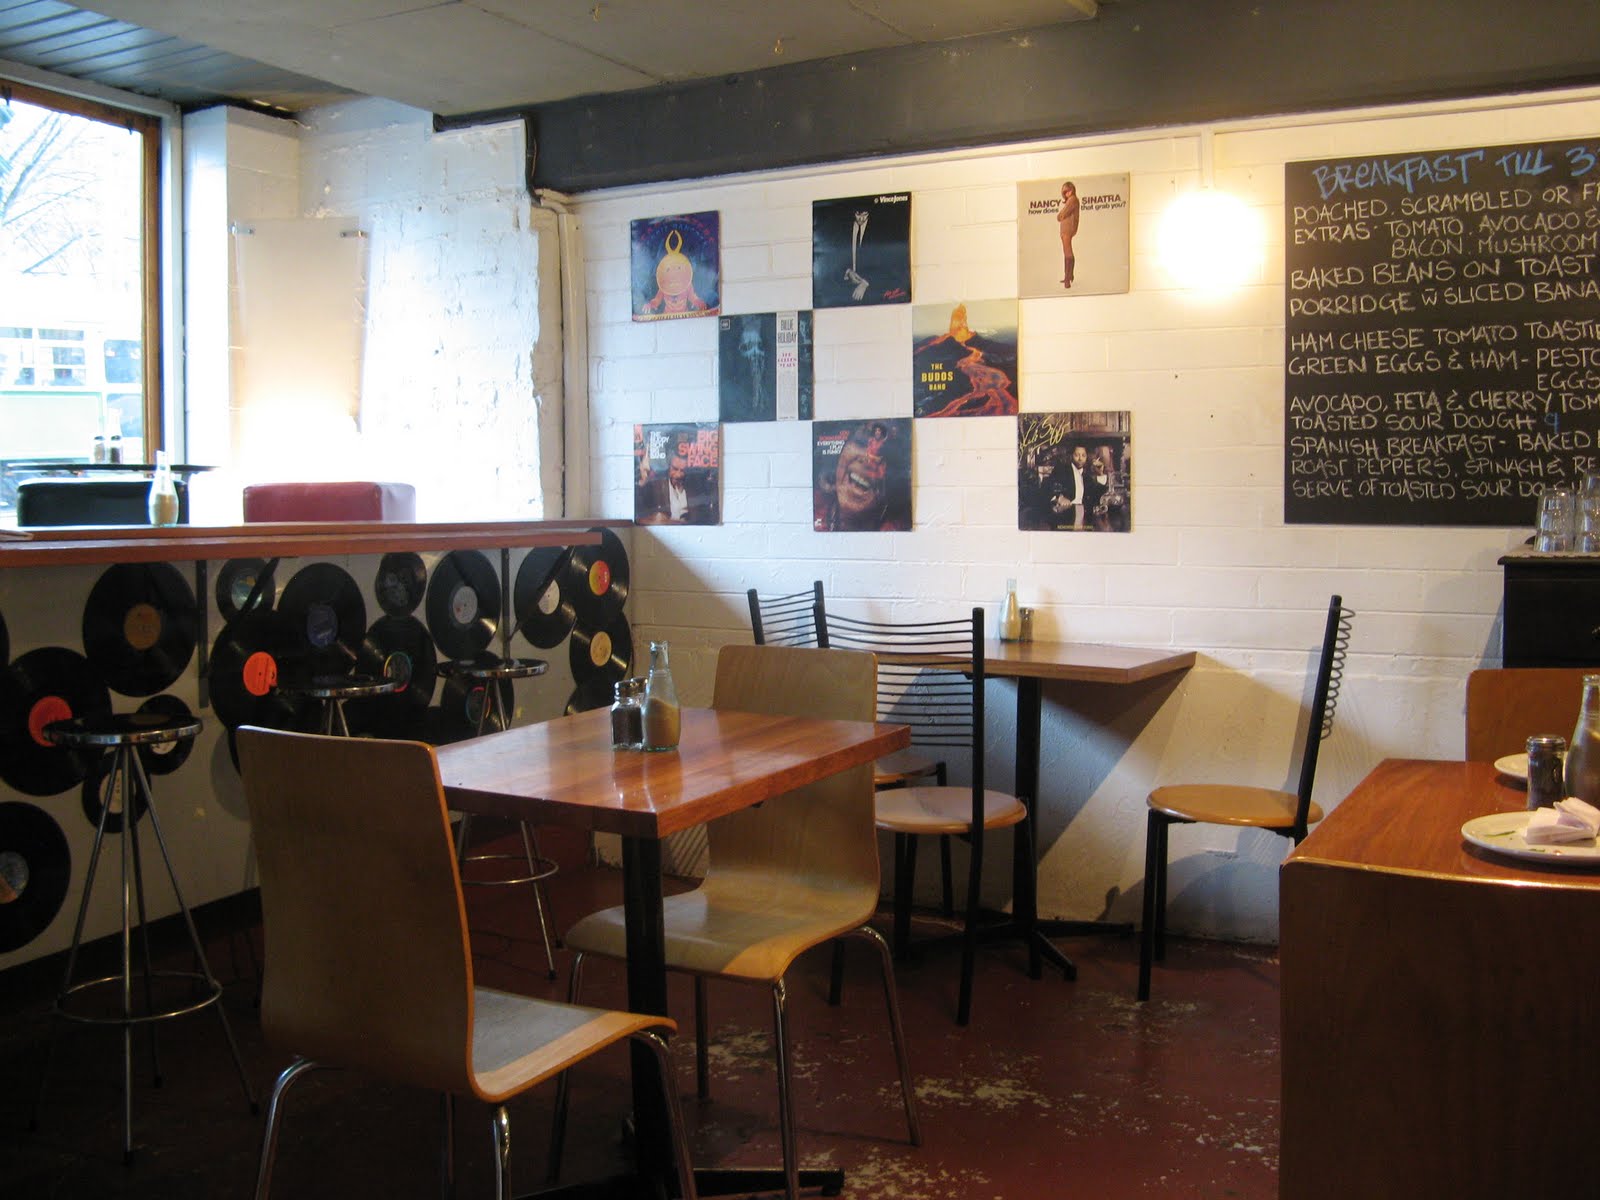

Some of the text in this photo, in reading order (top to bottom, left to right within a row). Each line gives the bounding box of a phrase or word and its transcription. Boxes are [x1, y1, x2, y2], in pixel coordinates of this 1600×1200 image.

[1312, 150, 1485, 200] BREAKFAST
[1495, 147, 1553, 177] TILL
[1028, 208, 1042, 216] how
[1043, 206, 1059, 214] does
[1094, 202, 1110, 211] grab
[1030, 194, 1121, 209] NANCY SINATRA
[1401, 189, 1532, 216] SCRAMBLED
[1542, 185, 1572, 205] OR
[1479, 210, 1581, 236] AVOCADO
[1291, 254, 1596, 291] BAKED BEANS ON TOAST
[1289, 291, 1417, 318] PORRIDGE
[1443, 282, 1525, 305] SLICED
[1291, 331, 1335, 354] HAM
[1340, 326, 1425, 352] CHEESE
[1433, 324, 1518, 346] TOMATO
[1288, 355, 1368, 376] GREEN
[1375, 350, 1442, 375] EGGS
[1447, 348, 1464, 370] &
[921, 371, 954, 382] BUDOS
[1393, 389, 1442, 414] FETA
[1446, 389, 1465, 411] &
[1469, 389, 1554, 414] CHERRY
[1290, 413, 1379, 433] TOASTED
[1385, 411, 1445, 432] SOUR
[1453, 411, 1538, 431] DOUGH
[678, 440, 718, 456] SWING
[698, 430, 718, 442] BIG
[1290, 436, 1379, 460] SPANISH
[1517, 430, 1592, 453] BAKED
[687, 455, 719, 467] FACE
[1291, 458, 1349, 480] ROAST
[1464, 456, 1544, 478] SPINACH
[1292, 479, 1354, 499] SERVE
[1461, 479, 1513, 499] SOUR
